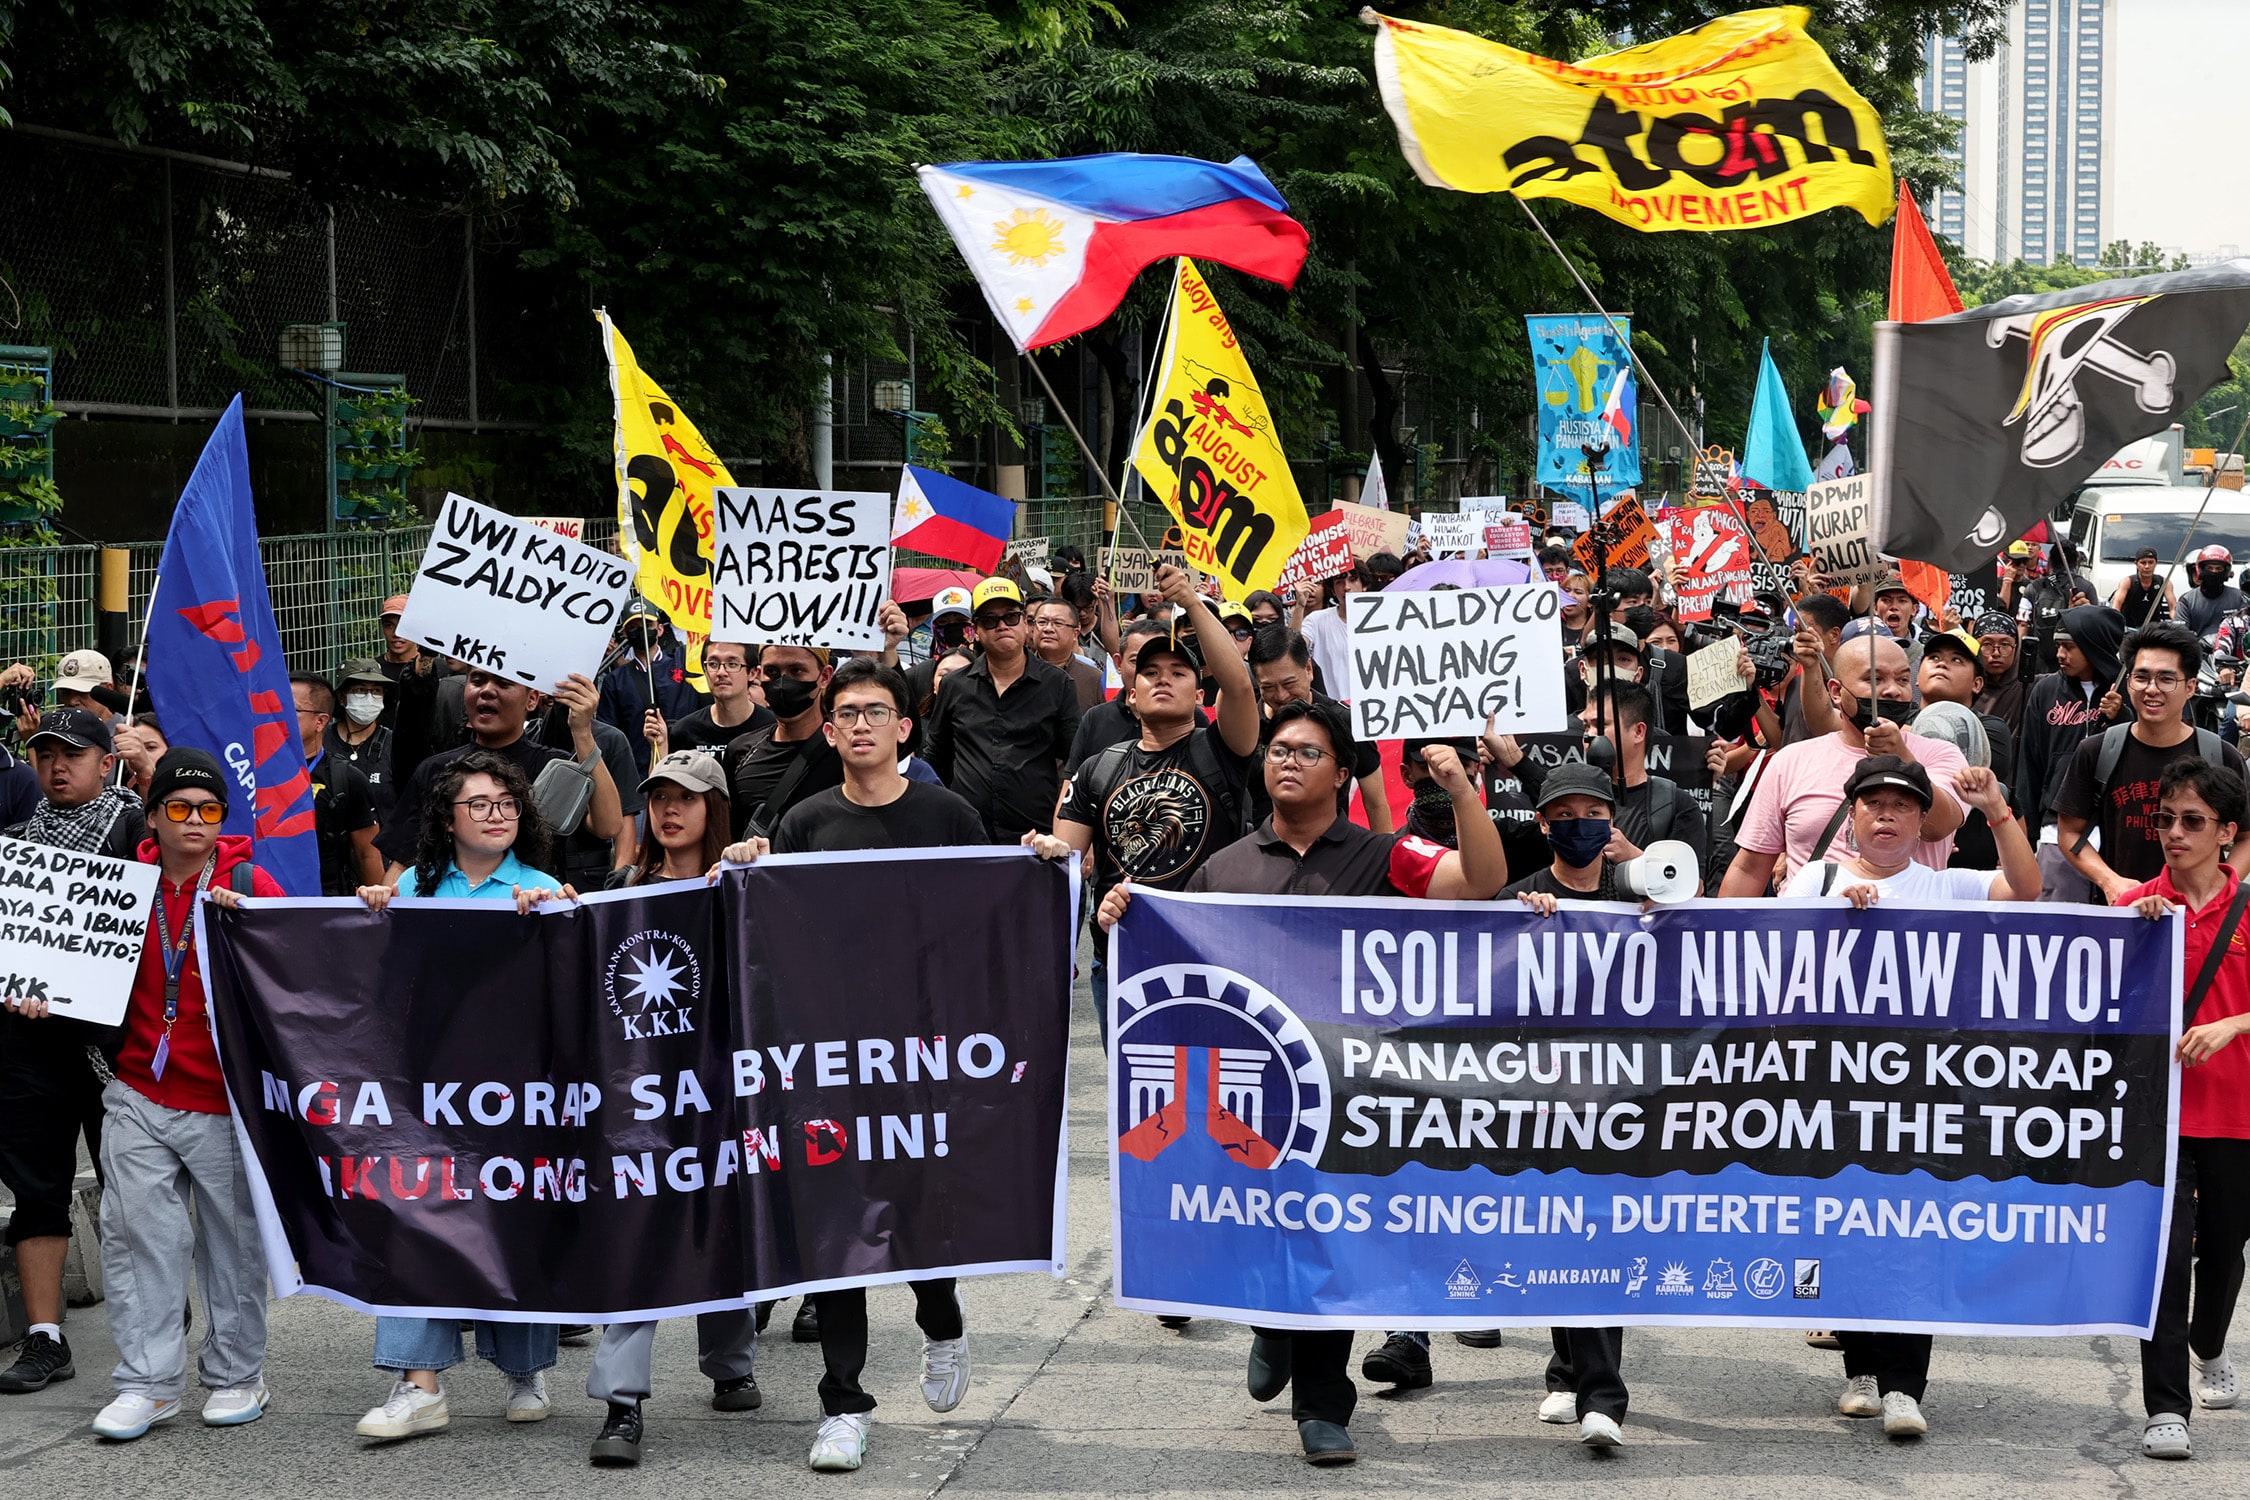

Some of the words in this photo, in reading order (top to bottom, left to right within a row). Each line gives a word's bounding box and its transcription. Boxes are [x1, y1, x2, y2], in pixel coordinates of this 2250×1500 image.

[1190, 422, 1268, 492] AUGUST
[1566, 474, 1612, 484] KABATAN
[1811, 481, 1863, 510] DPWH
[448, 500, 518, 556] UWI
[717, 489, 856, 536] MASS
[1778, 506, 1804, 549] TUTA
[1809, 504, 1869, 542] KURAP!
[1020, 548, 1036, 559] ANG
[1312, 543, 1350, 574] NOW!
[1431, 532, 1476, 547] MATAKOT
[714, 541, 886, 586] ARRESTS
[1856, 570, 1888, 585] SINNG-
[722, 582, 883, 640] NOW!!!
[1354, 634, 1518, 690] WALANG
[1690, 666, 1710, 686] EAT
[1711, 660, 1734, 678] THE
[1695, 640, 1736, 670] HUNGRY
[1360, 675, 1527, 737] BAYAG!
[51, 853, 125, 882] DPWH
[67, 882, 137, 910] PANO
[38, 905, 74, 926] SA
[83, 911, 145, 936] IBANG
[158, 911, 170, 950] NURSING
[0, 923, 142, 963] RTAMENTO?
[605, 952, 623, 1016] KALAYAAN
[619, 929, 668, 953] KONTRA
[672, 934, 701, 999] KORAPSYON
[1340, 928, 1493, 1017] ISOLI
[1515, 930, 1658, 1017] NIYO
[1679, 929, 1962, 1018] NINAKAW
[1980, 933, 2125, 1023] NYO!
[621, 1006, 696, 1041] K.K.K
[261, 1069, 393, 1126] MGA
[422, 1081, 602, 1127] KORAP
[630, 1069, 712, 1122] SA
[732, 1032, 1028, 1098] BYERNO,
[1342, 1037, 1643, 1086] PANAGUTIN
[1661, 1040, 1816, 1086] LAHAT
[1830, 1041, 1911, 1086] NG
[1925, 1043, 2129, 1100] KORAP,
[1341, 1094, 1646, 1151] STARTING
[1660, 1098, 1835, 1151] FROM
[1849, 1100, 1964, 1155] THE
[1979, 1105, 2125, 1161] TOP!
[318, 1155, 587, 1202] IKULONG
[804, 1112, 950, 1167] DIN!
[1169, 1183, 1372, 1234] MARCOS
[1384, 1192, 1598, 1242] SINGILIN,
[1611, 1194, 1801, 1235] DUTERTE
[1814, 1195, 2107, 1244] PANAGUTIN!
[1526, 1269, 1621, 1285] ANAKBAYAN
[1656, 1284, 1694, 1292] KABATAAN
[1706, 1291, 1733, 1299] NUSP
[1795, 1287, 1818, 1296] SCM
